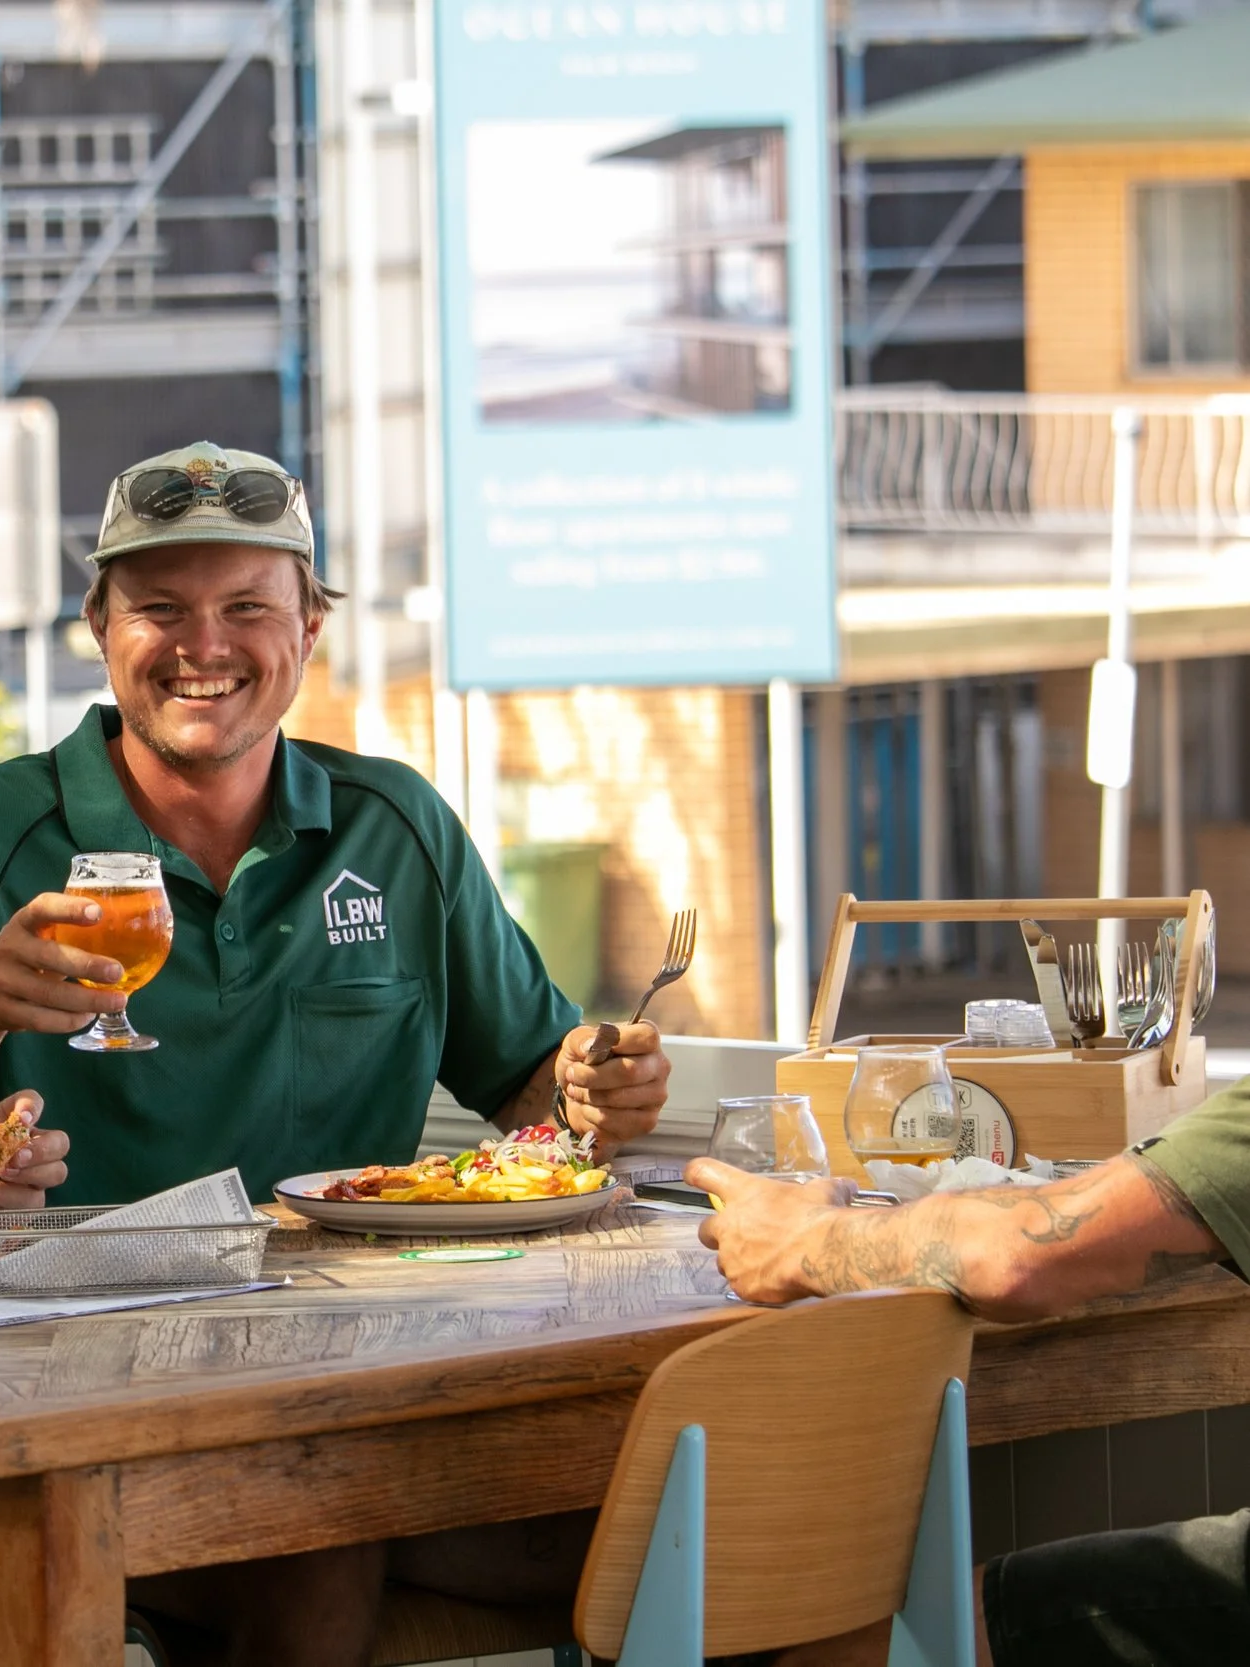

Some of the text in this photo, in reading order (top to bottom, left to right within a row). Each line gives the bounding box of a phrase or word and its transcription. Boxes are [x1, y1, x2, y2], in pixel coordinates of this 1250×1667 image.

[332, 896, 383, 927] LBW
[327, 925, 387, 945] BUILT
[993, 1120, 1002, 1150] menu
